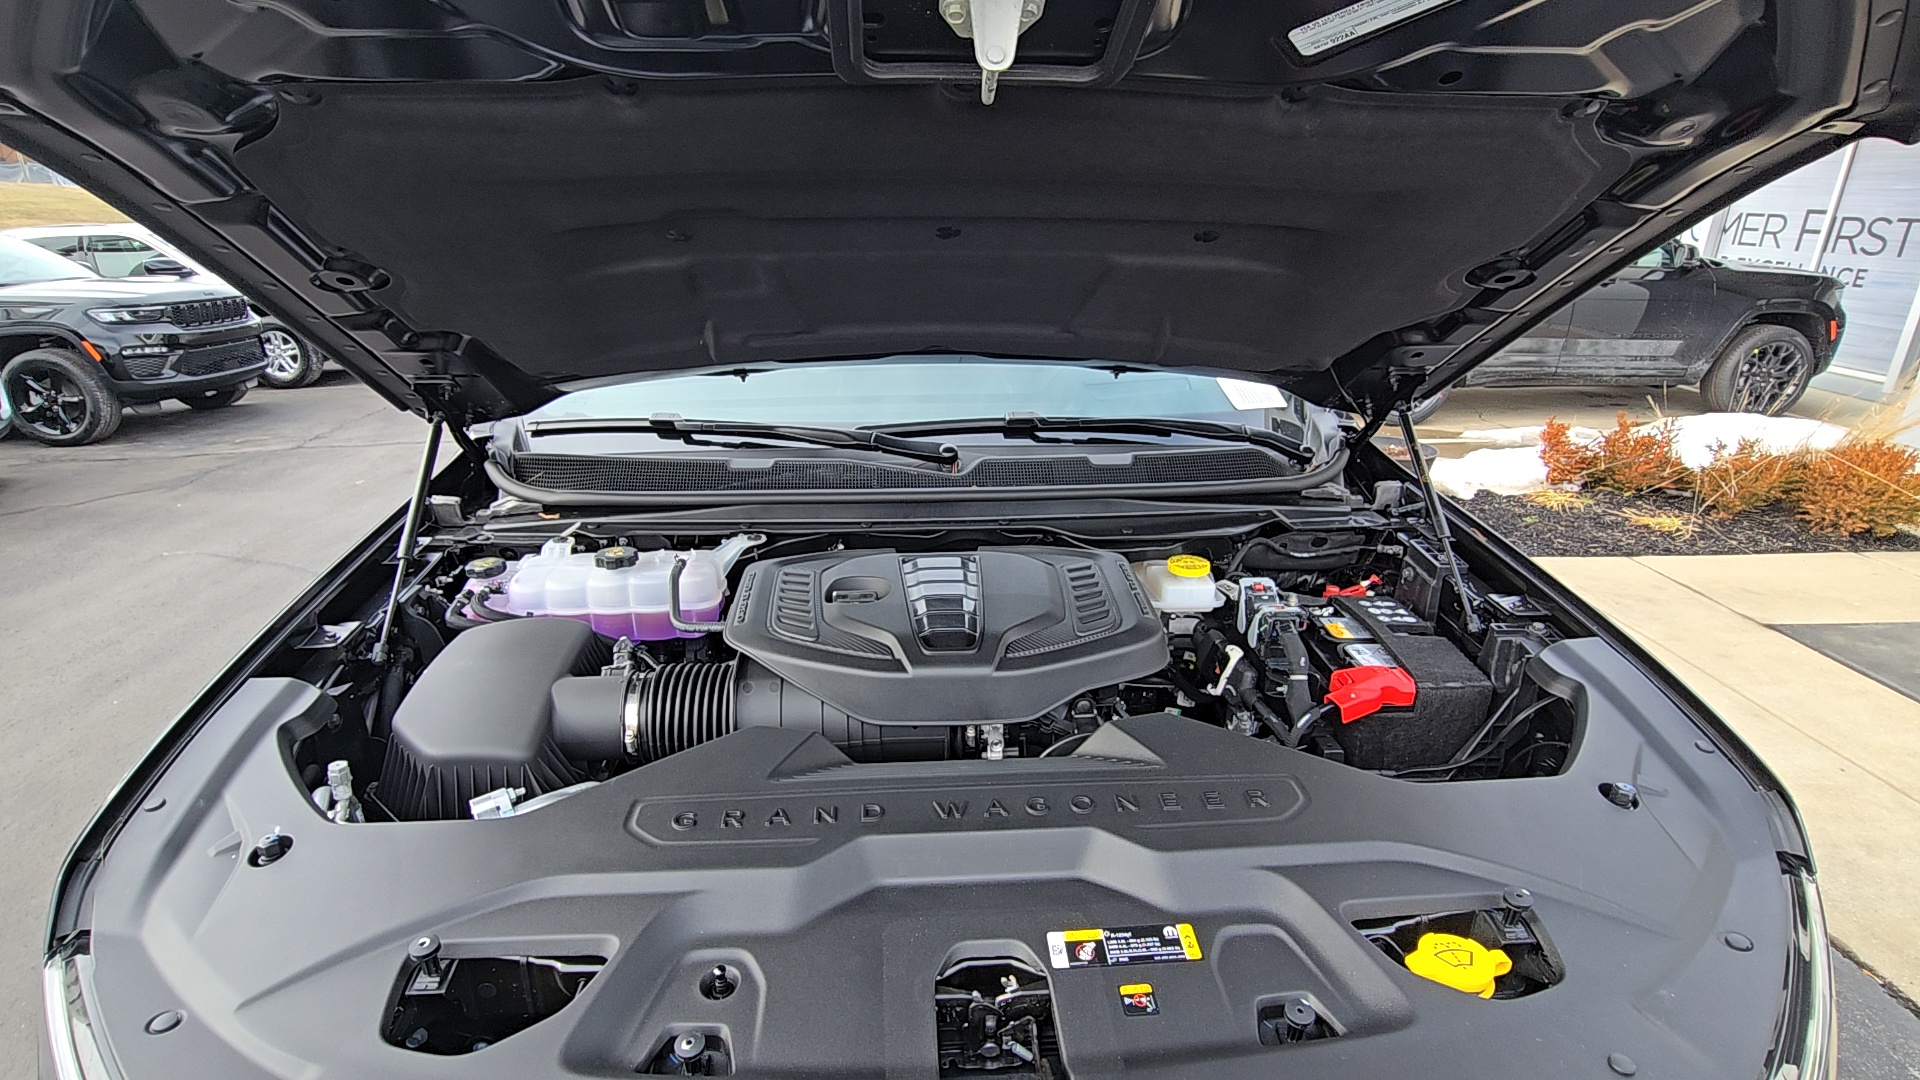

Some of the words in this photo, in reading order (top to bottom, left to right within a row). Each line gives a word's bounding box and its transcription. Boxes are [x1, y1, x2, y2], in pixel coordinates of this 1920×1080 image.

[1330, 30, 1356, 44] 922AA
[671, 802, 885, 831] GRAND
[931, 789, 1271, 820] WAGONEER
